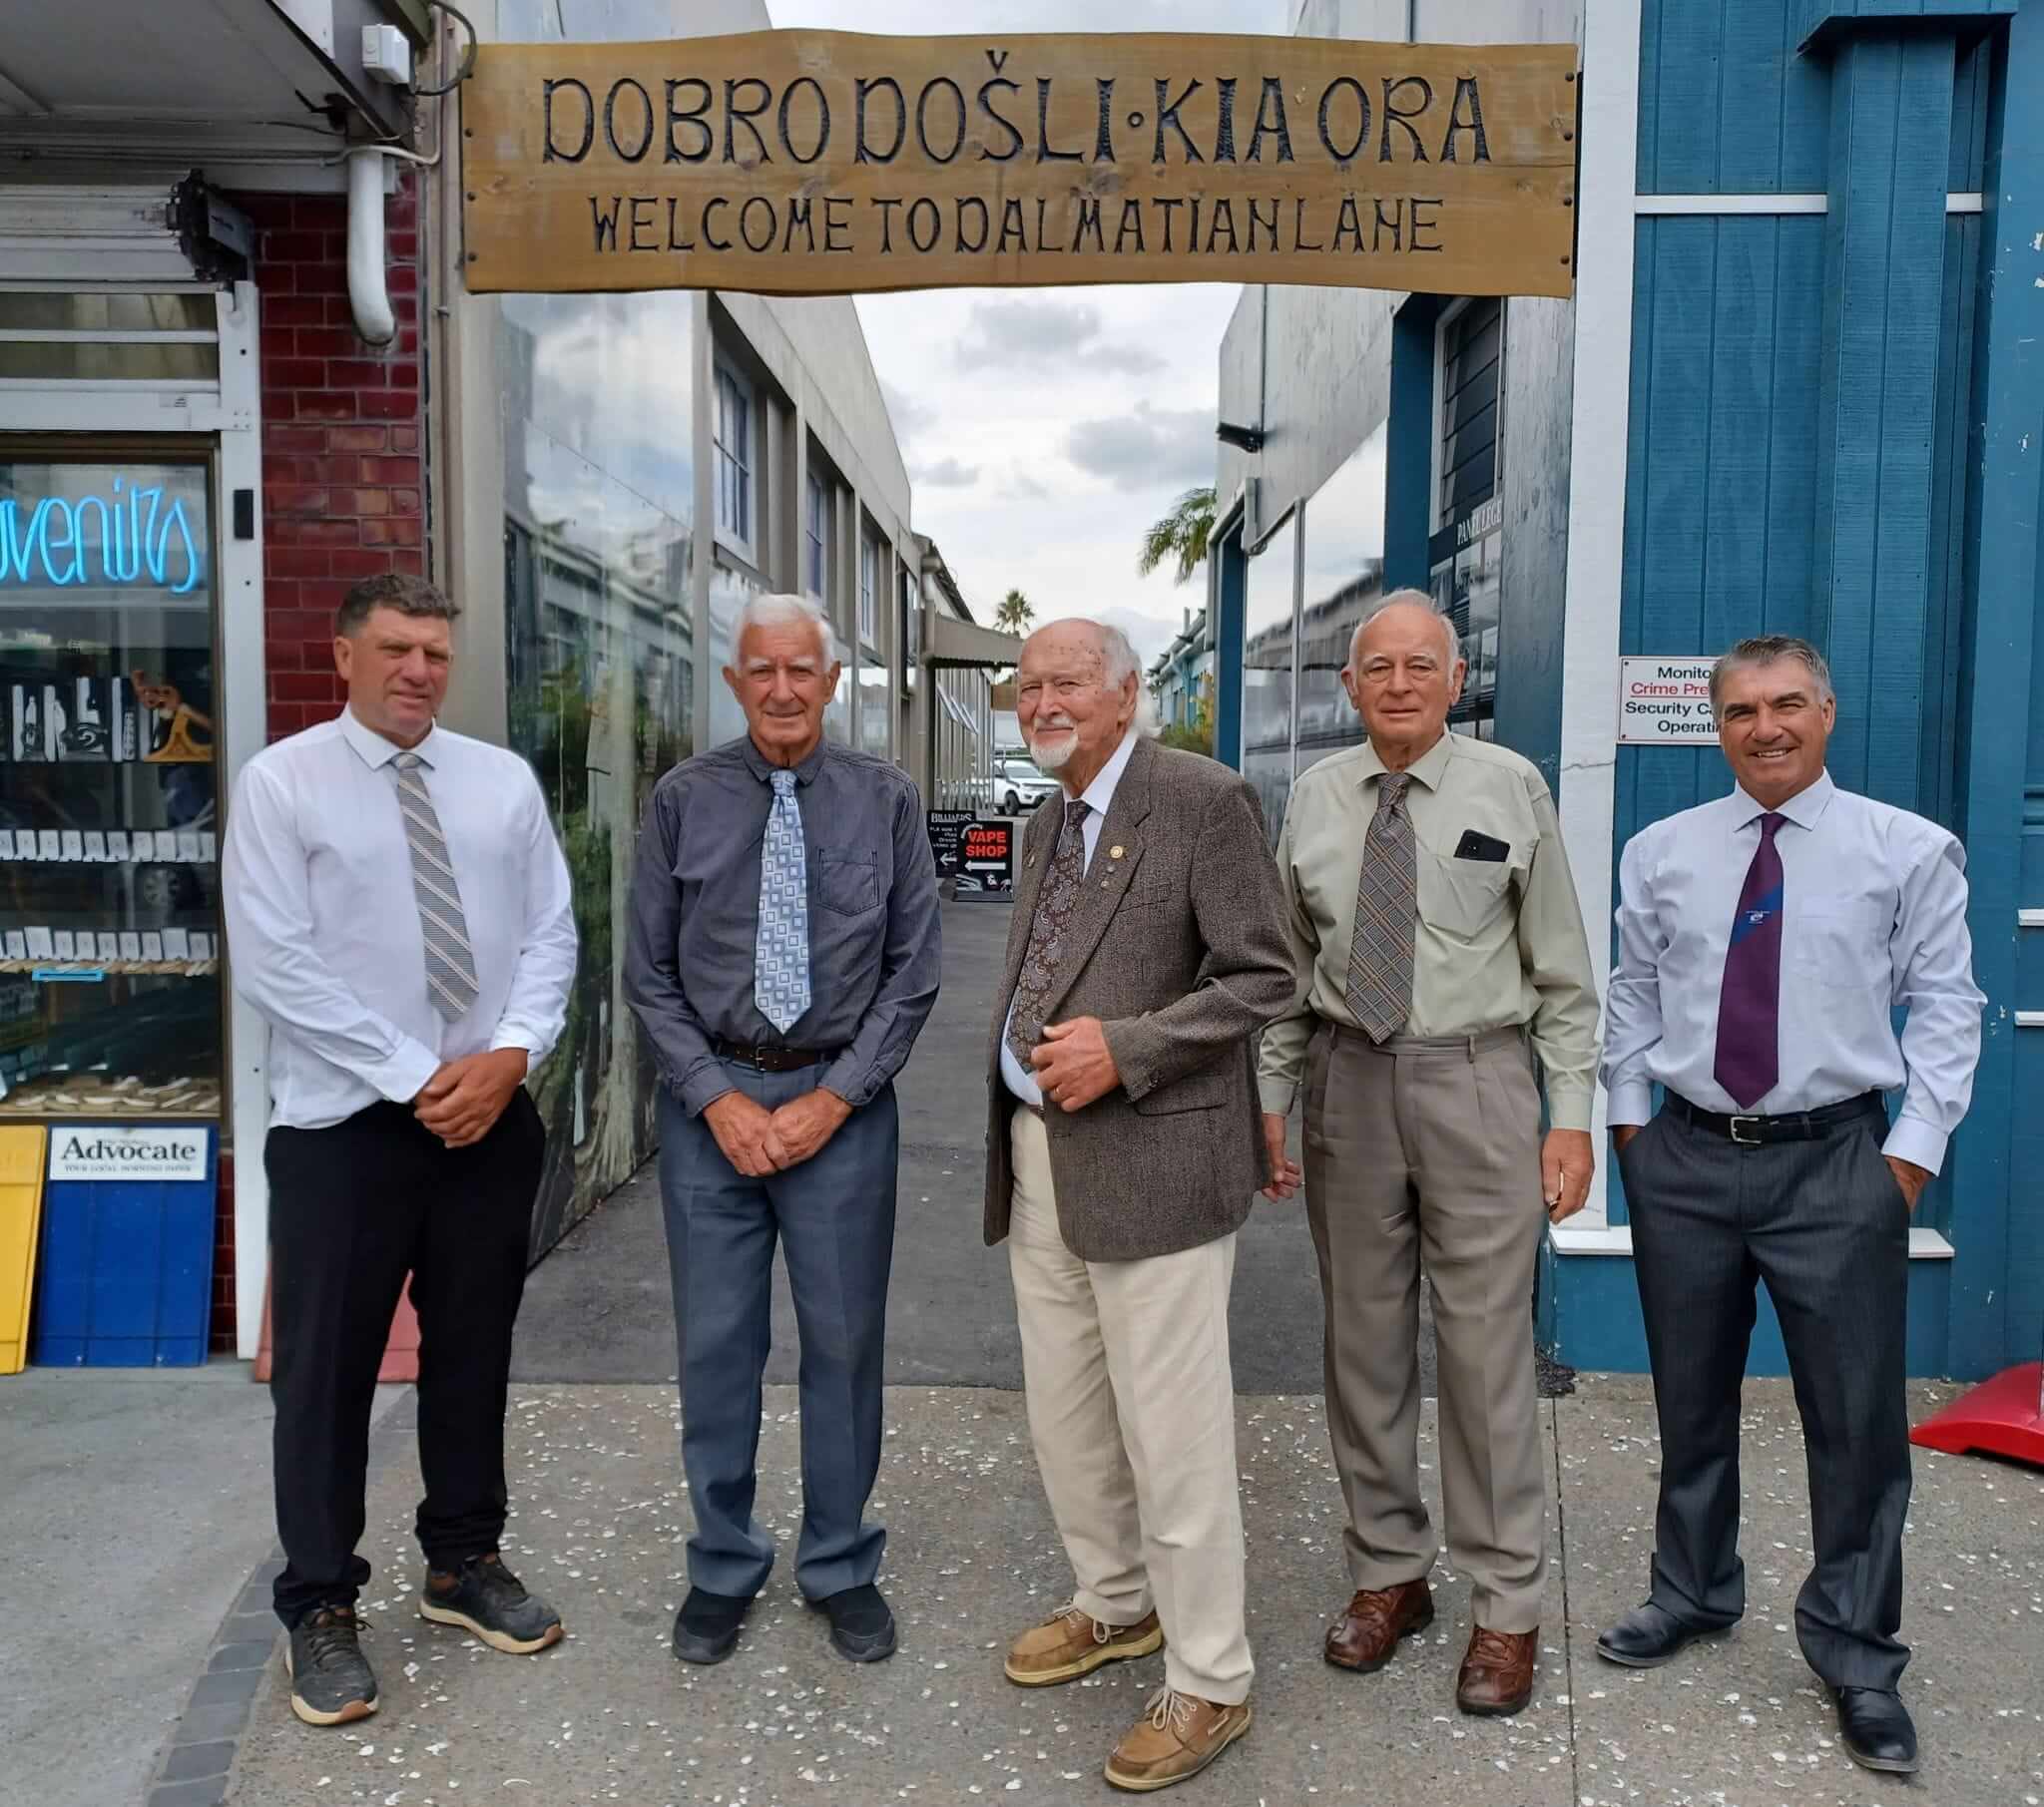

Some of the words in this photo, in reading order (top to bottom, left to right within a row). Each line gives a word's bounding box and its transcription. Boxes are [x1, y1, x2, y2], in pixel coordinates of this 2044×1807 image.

[542, 76, 830, 166] DOBRO
[1151, 76, 1295, 165] KIA
[1316, 75, 1493, 165] ORA
[588, 197, 855, 254] WELCOME
[870, 197, 941, 254] TO
[954, 196, 1280, 254] DALMATIAN
[1292, 196, 1444, 253] LANE
[1657, 667, 1712, 679] Monito
[1631, 682, 1679, 695] Crime
[1684, 682, 1709, 695] Pre
[1625, 701, 1692, 717] Security
[1697, 702, 1713, 715] C
[1658, 719, 1720, 734] Operati
[967, 830, 1007, 843] VAPE
[965, 845, 1007, 857] SHOP
[61, 1135, 198, 1160] Advocate
